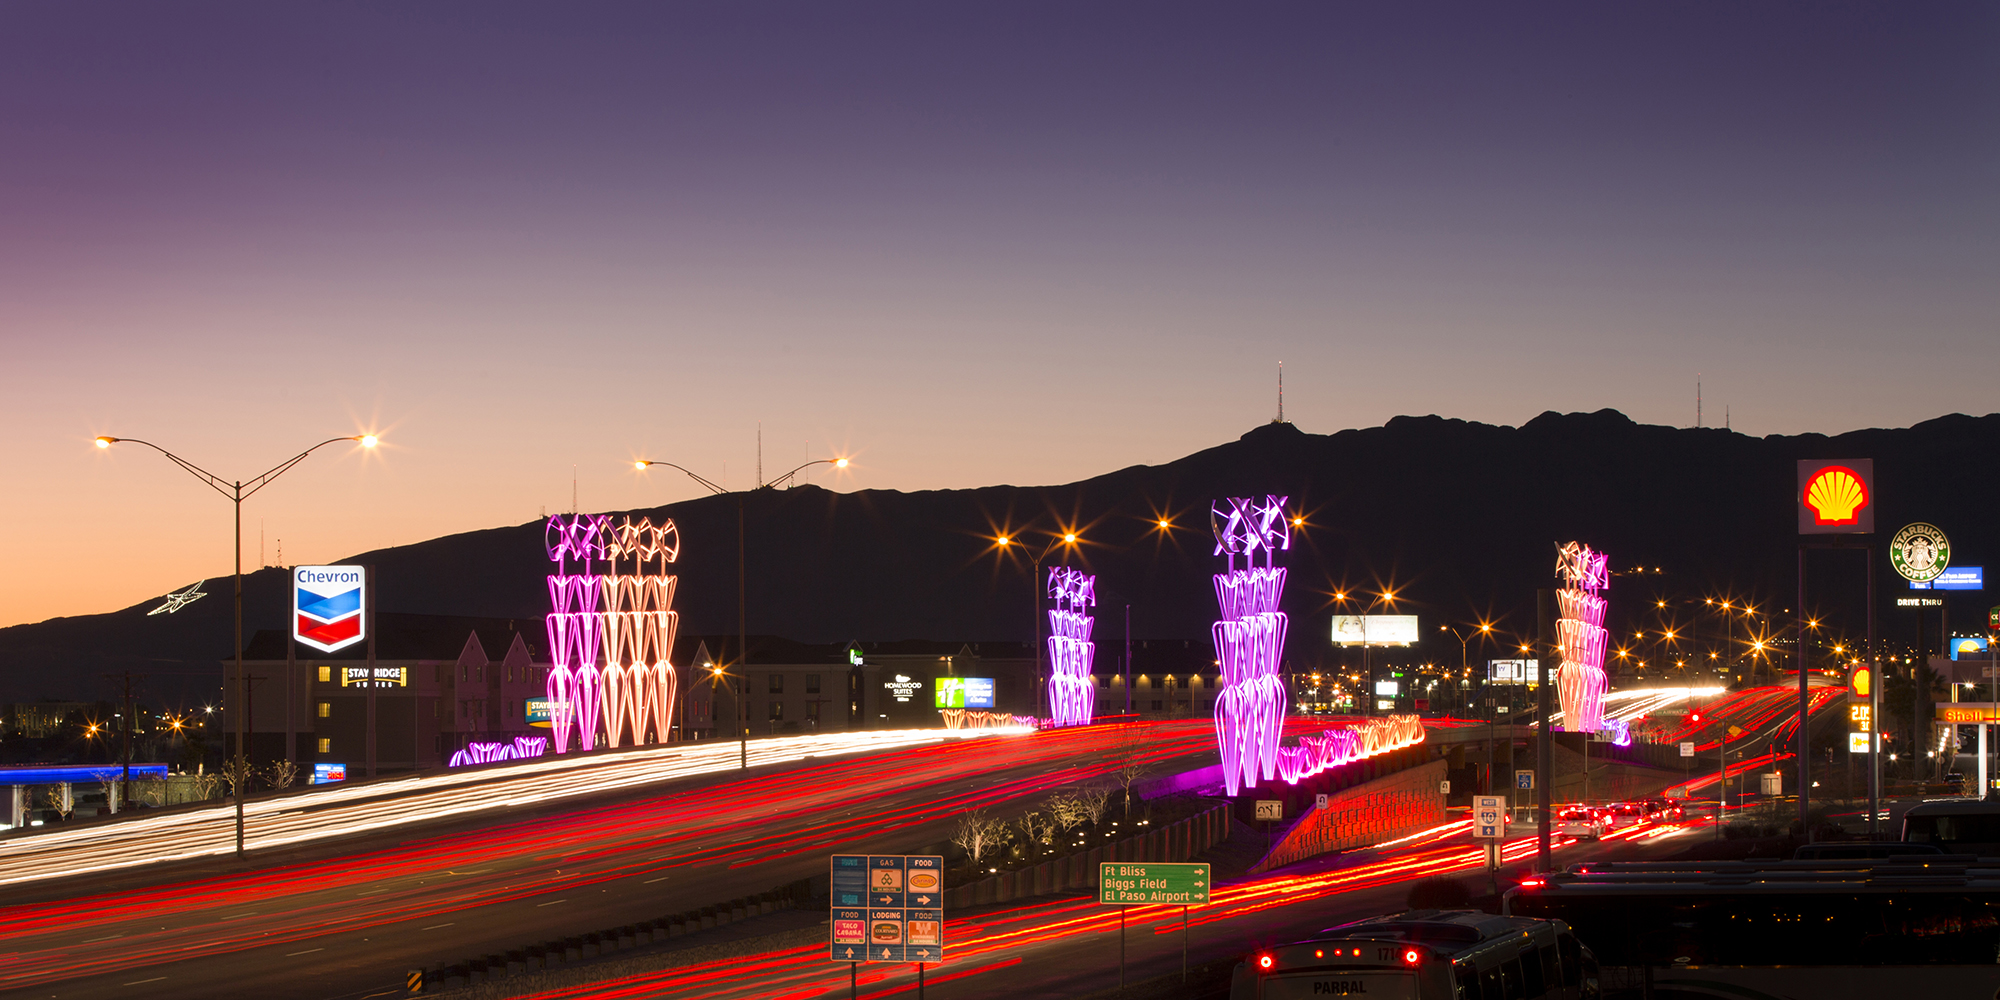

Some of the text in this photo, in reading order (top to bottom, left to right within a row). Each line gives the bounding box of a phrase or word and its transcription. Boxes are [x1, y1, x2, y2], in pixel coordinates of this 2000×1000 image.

[1894, 525, 1947, 550] STARBUCKS
[297, 570, 360, 583] Chevron
[1899, 564, 1940, 579] COFFEE
[348, 668, 400, 677] STAYRIDGE
[1945, 711, 1982, 721] Shell
[1483, 812, 1495, 822] 10
[1105, 866, 1146, 876] Ft Bliss
[1105, 878, 1167, 890] Biggs Field
[1105, 891, 1189, 903] El Paso Airport
[1314, 981, 1367, 994] PARRAL
